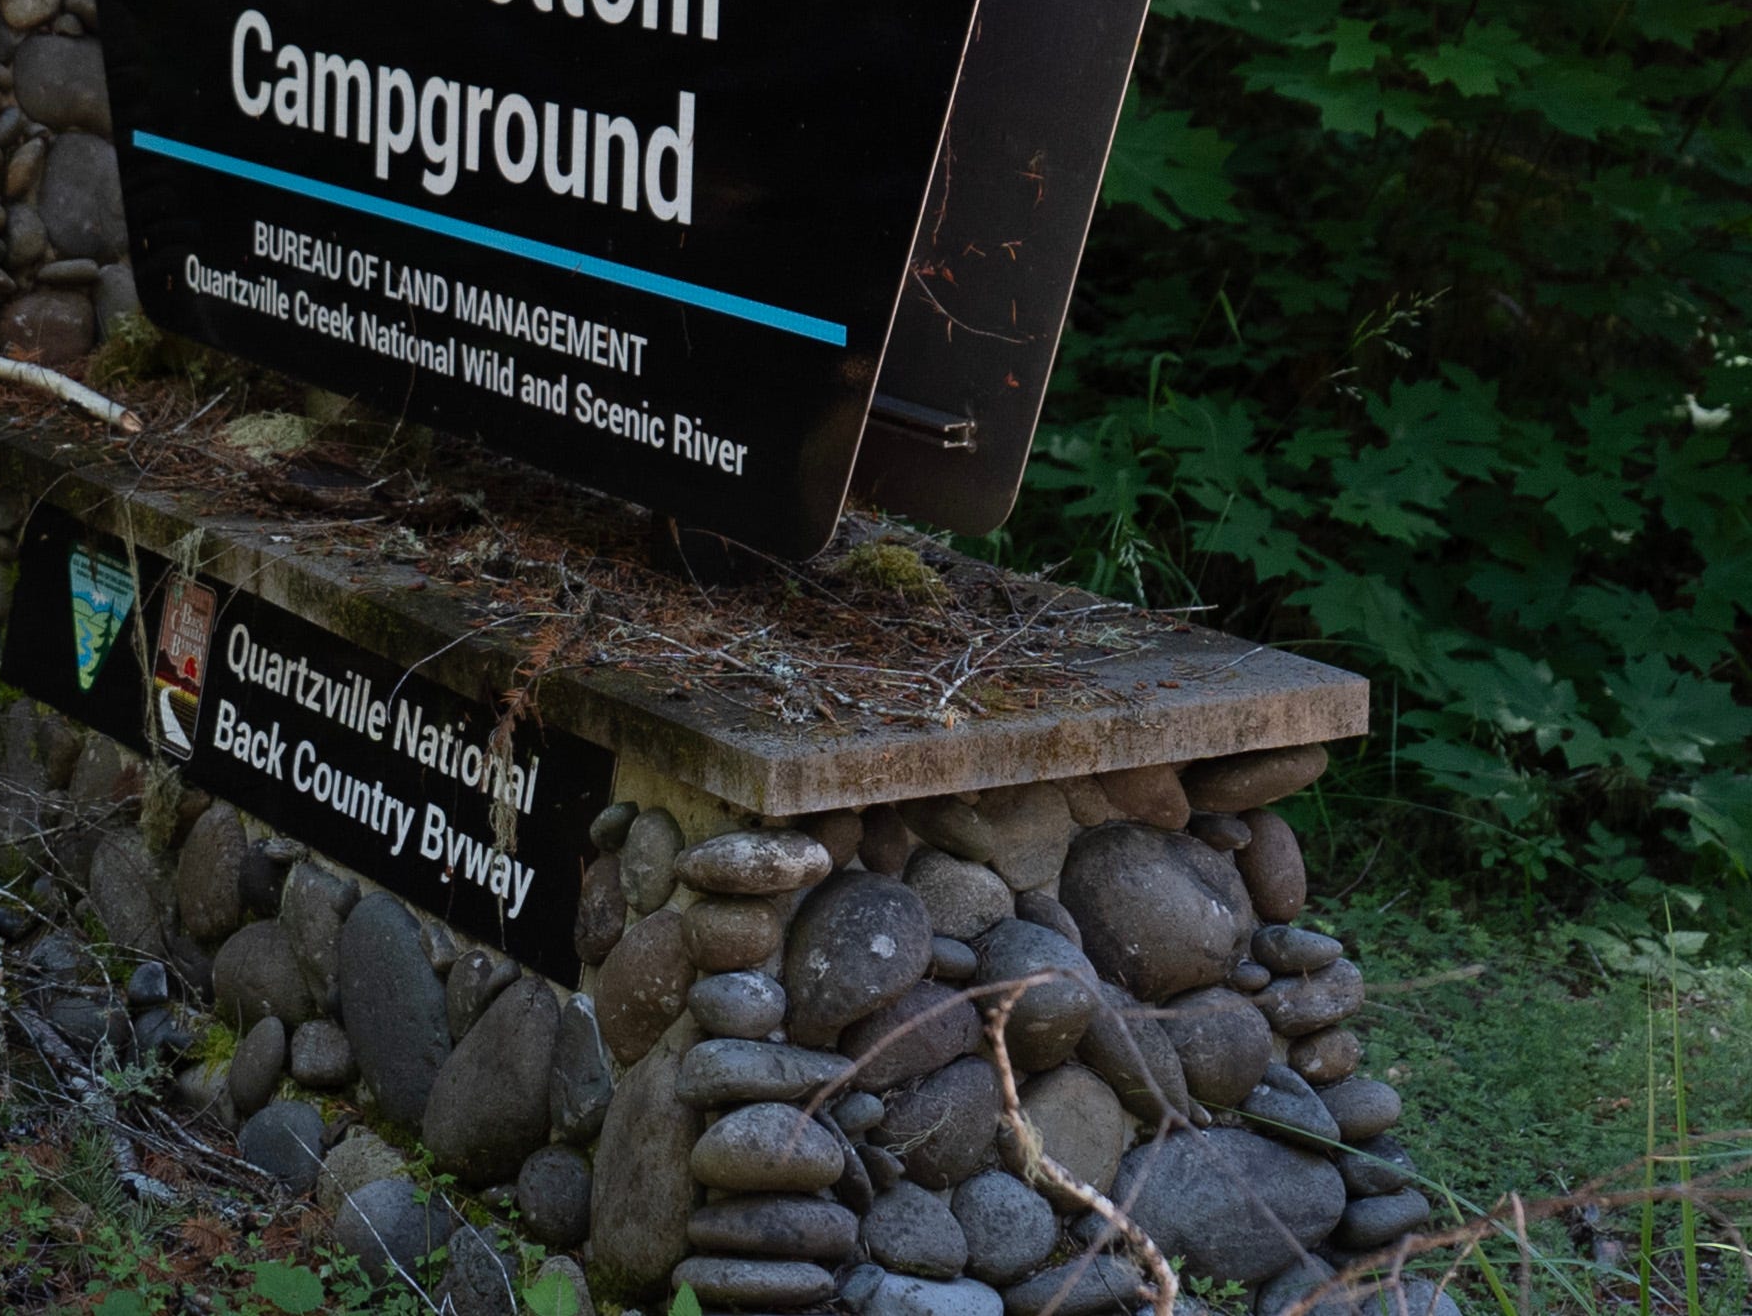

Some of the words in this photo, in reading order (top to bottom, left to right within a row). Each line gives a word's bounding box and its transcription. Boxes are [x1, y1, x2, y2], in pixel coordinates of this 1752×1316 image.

[231, 8, 696, 225] Campground
[185, 253, 290, 320] Quartzville
[294, 289, 355, 343] Creek
[360, 310, 455, 377] National
[461, 343, 515, 398] Wild
[520, 374, 567, 416] and
[574, 382, 666, 449] Scenic
[673, 413, 748, 476] River
[254, 220, 342, 281] BUREAU
[348, 250, 379, 290] OF
[384, 260, 449, 314] LAND
[454, 281, 648, 376] MANAGEMENT
[213, 698, 287, 781] Back
[292, 739, 416, 857] Country
[419, 801, 535, 920] Byway
[227, 623, 387, 742] Quartzville
[393, 698, 540, 815] National
